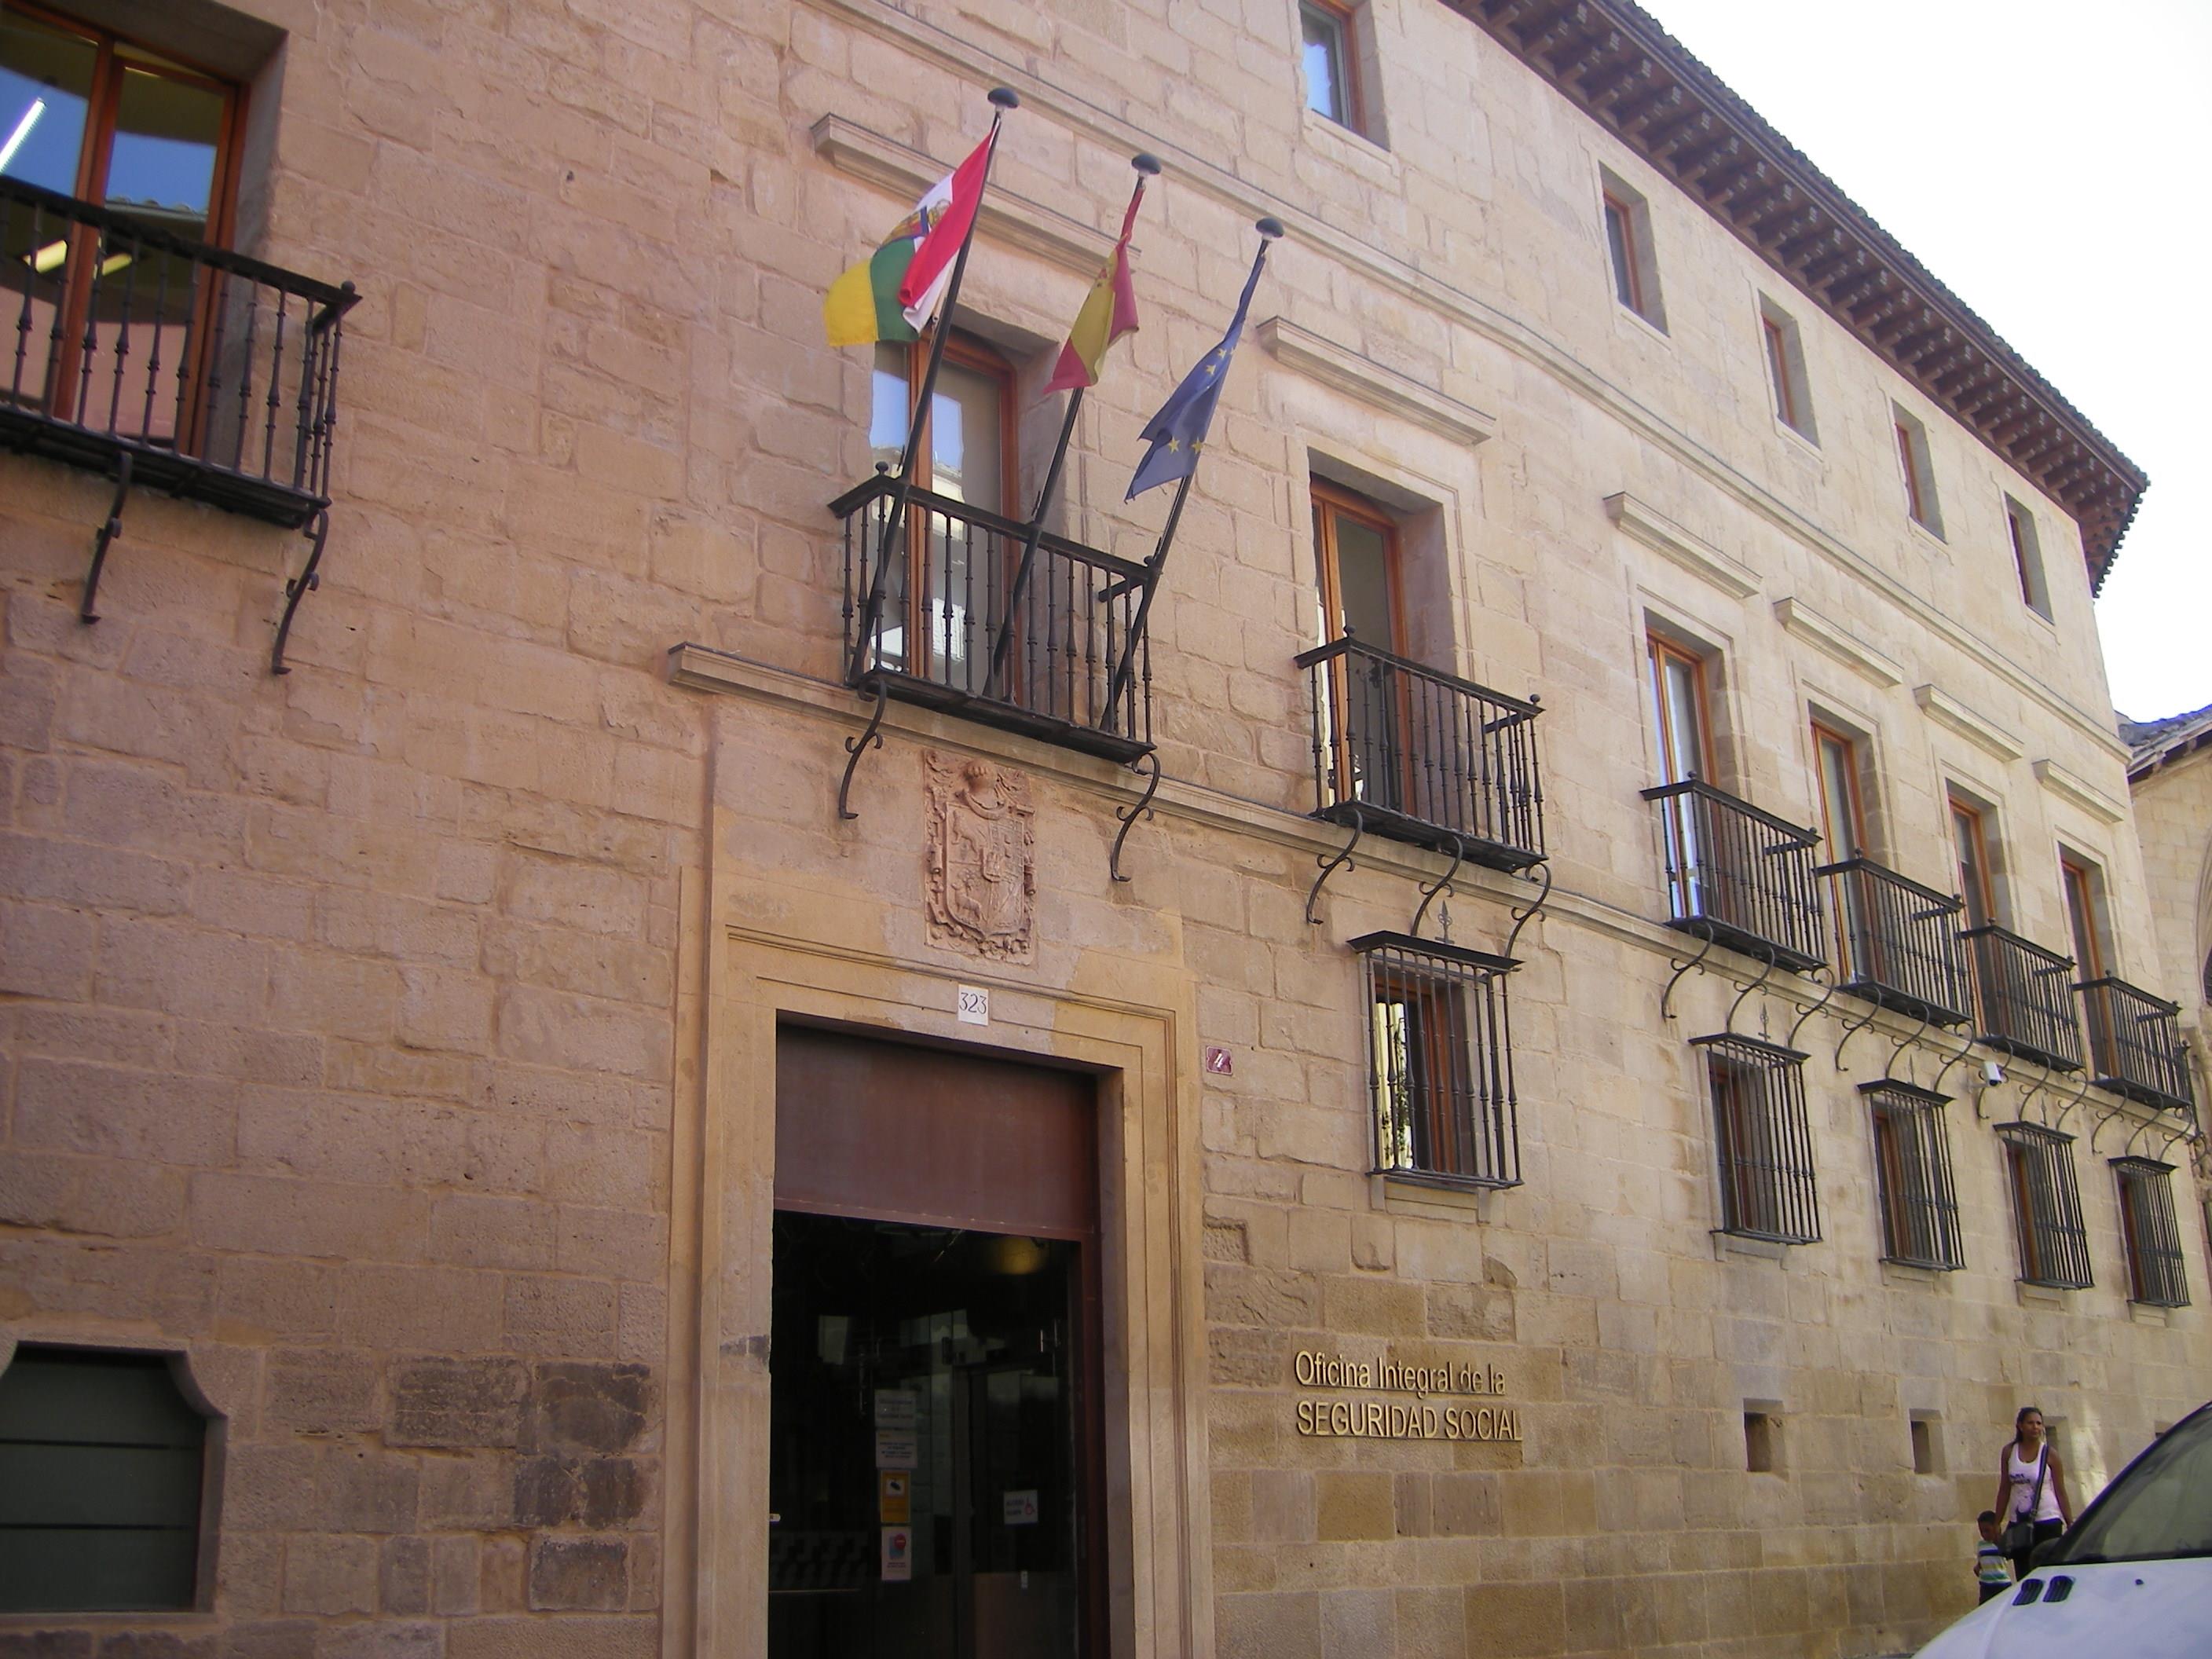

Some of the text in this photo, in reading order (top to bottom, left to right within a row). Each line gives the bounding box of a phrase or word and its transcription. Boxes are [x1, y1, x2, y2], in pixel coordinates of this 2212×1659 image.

[959, 992, 987, 1014] 323
[1295, 1350, 1506, 1399] Oficina Integral de la
[1297, 1401, 1523, 1441] SEGURIDAD SOCIAL
